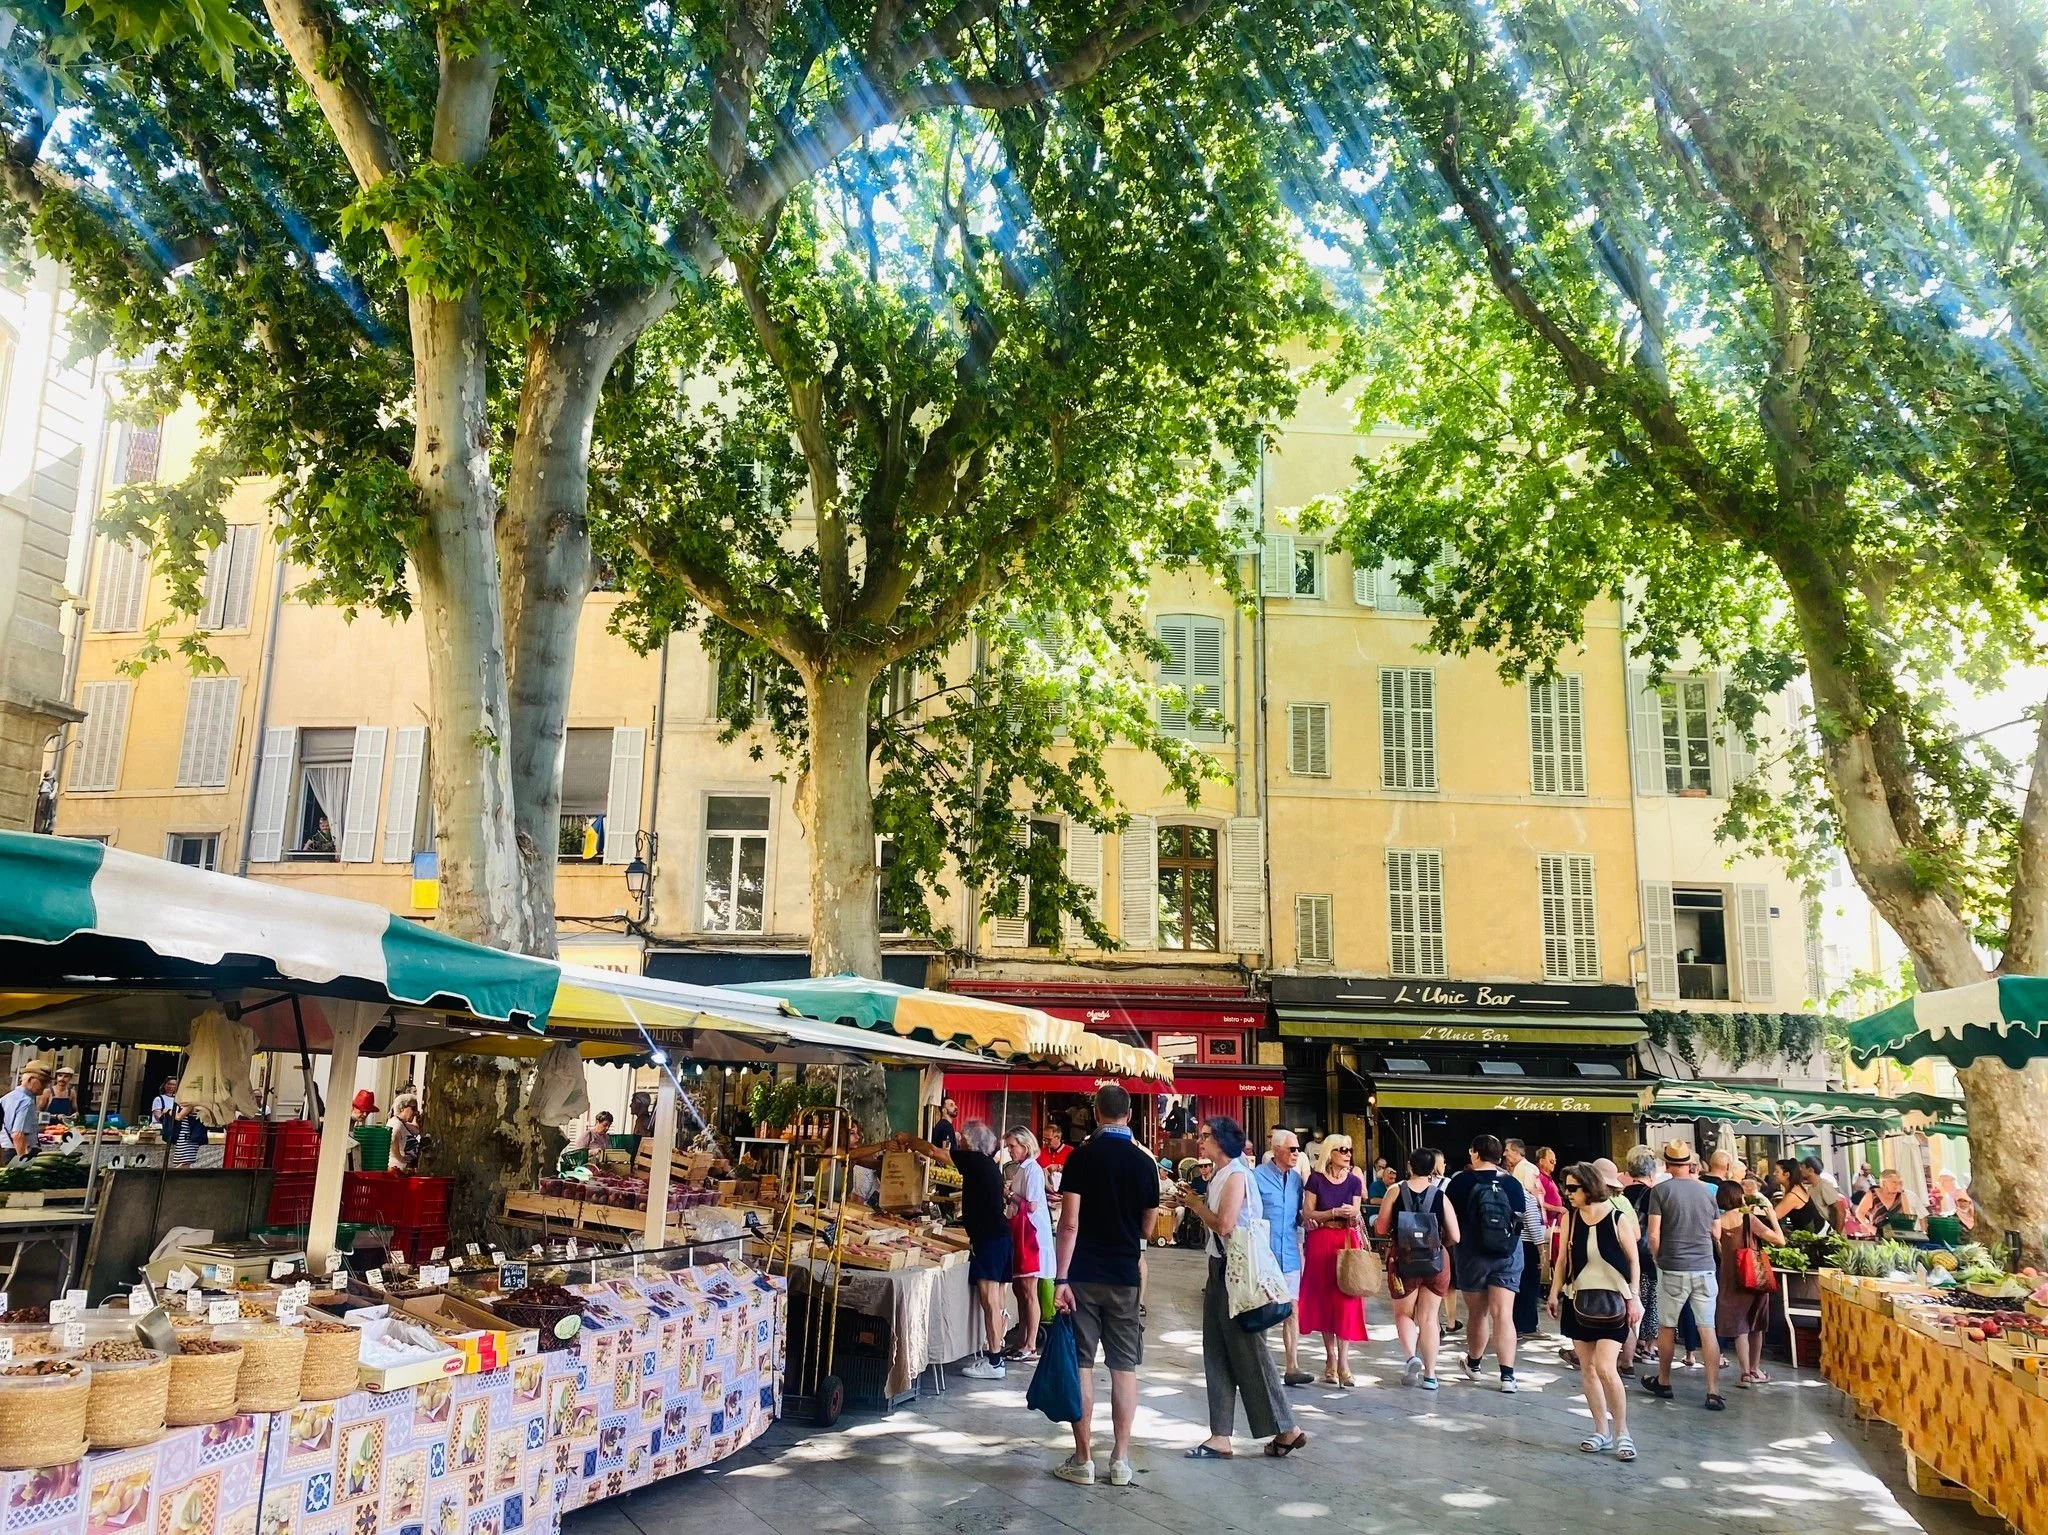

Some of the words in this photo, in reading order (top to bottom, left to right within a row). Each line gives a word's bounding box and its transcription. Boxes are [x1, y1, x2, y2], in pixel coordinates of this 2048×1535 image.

[1394, 985, 1469, 1005] L'Unic
[1476, 986, 1516, 1006] Bar
[1223, 1015, 1239, 1023] bistro
[1243, 1016, 1255, 1024] pub
[1419, 1026, 1475, 1040] L'Unic
[1481, 1028, 1510, 1041] Bar
[1239, 1083, 1256, 1091] bistro
[1260, 1084, 1274, 1093] pub
[1494, 1095, 1555, 1111] L'Unic
[1560, 1097, 1592, 1111] Bar
